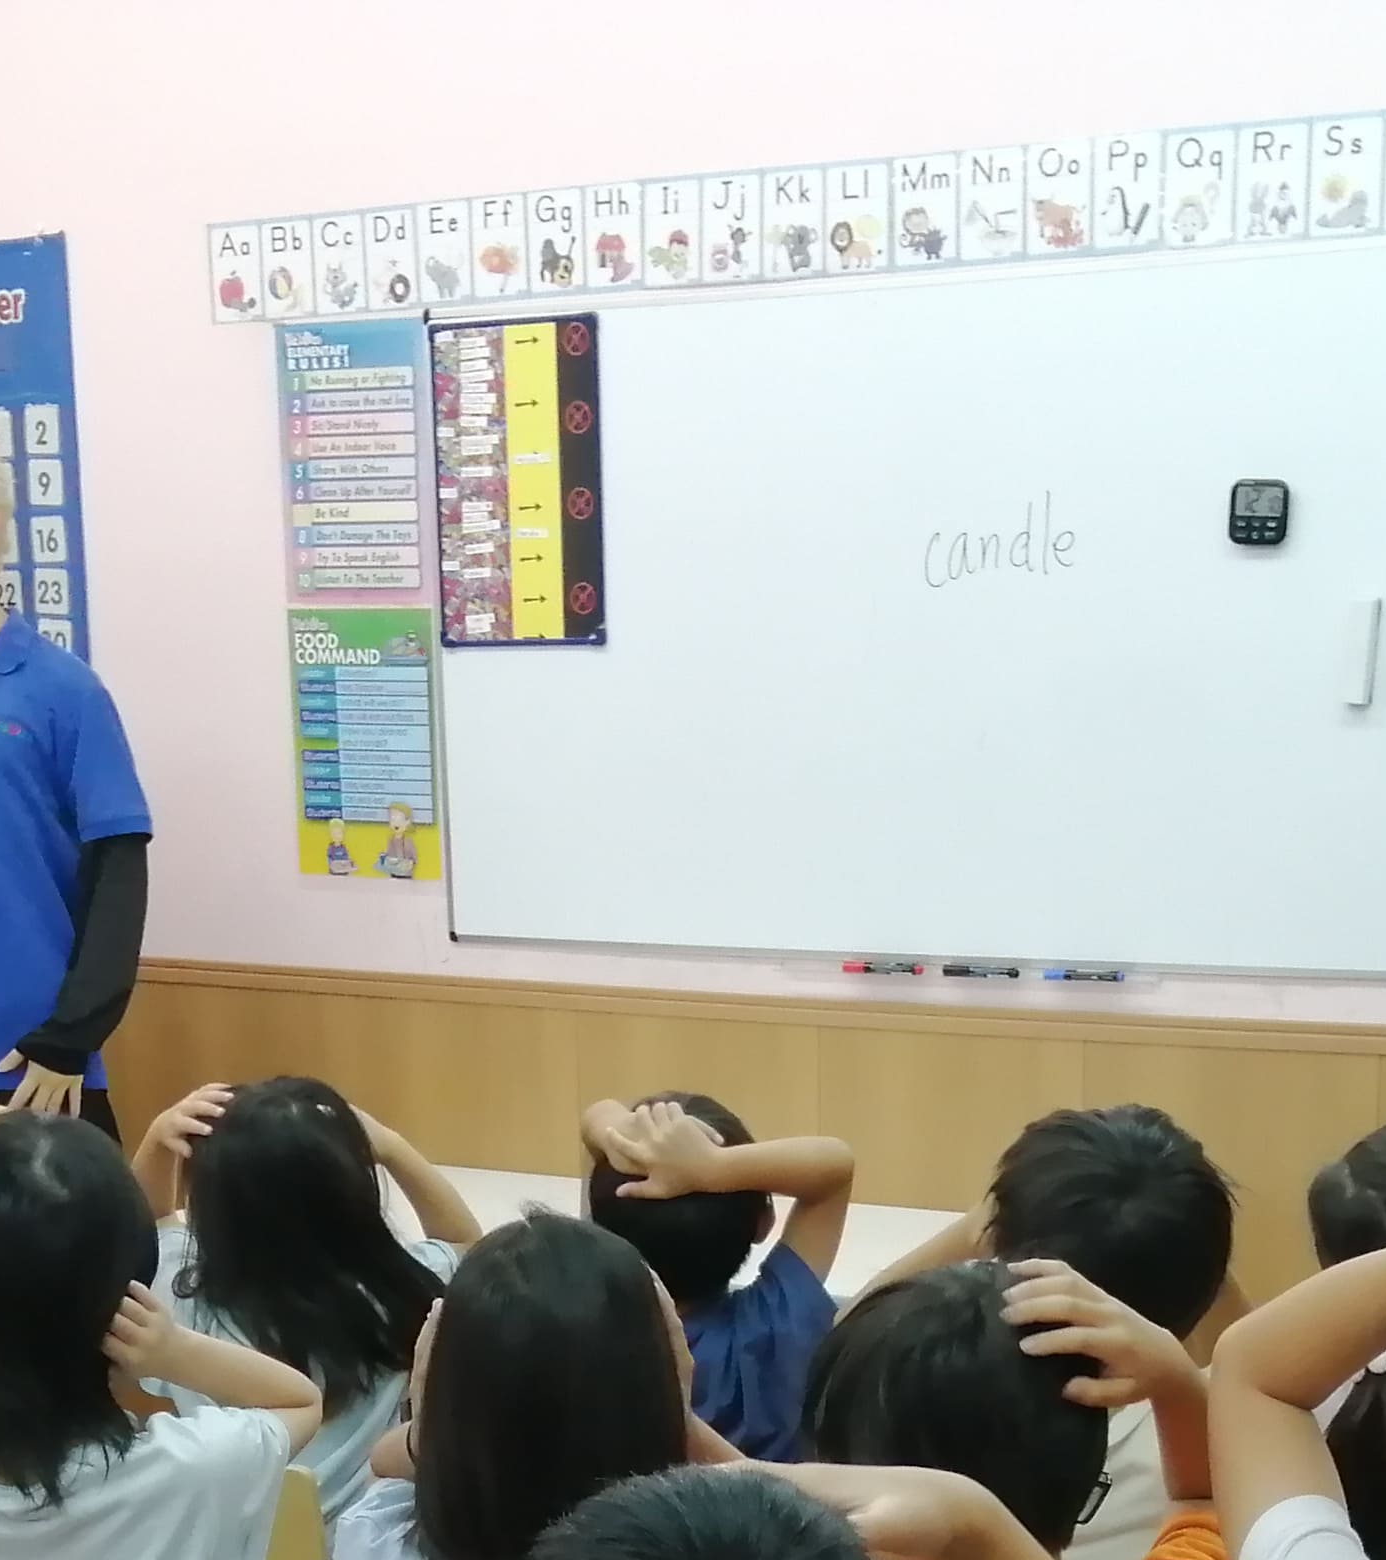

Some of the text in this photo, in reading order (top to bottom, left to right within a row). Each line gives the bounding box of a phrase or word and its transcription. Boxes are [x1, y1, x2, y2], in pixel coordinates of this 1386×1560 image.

[219, 232, 250, 257] Aa
[271, 225, 302, 253] Bb
[321, 221, 353, 248] Cc
[374, 214, 405, 242] Dd
[429, 207, 457, 234] Ee
[484, 200, 512, 228] Ff
[536, 195, 572, 233] Gg
[595, 188, 629, 217] Hh
[662, 186, 679, 214] Ii
[713, 180, 745, 220] Jj
[775, 176, 810, 204] Kk
[842, 169, 868, 199] Ll
[902, 161, 950, 192] Mm
[972, 154, 1010, 184] Nn
[1038, 147, 1079, 177] Oo
[1109, 140, 1147, 181] Pp
[1177, 137, 1222, 180] Qq
[1253, 131, 1291, 163] Rr
[1325, 125, 1362, 156] Ss
[287, 356, 349, 370] RULES!
[293, 399, 301, 413] 2
[35, 421, 48, 445] 2
[293, 421, 302, 434] 3
[295, 464, 303, 478] 5
[38, 472, 51, 496] 9
[296, 487, 304, 499] 6
[329, 507, 350, 518] Kind
[36, 528, 59, 553] 16
[924, 490, 1076, 588] candle
[37, 580, 63, 605] 23
[295, 633, 339, 649] FOOD
[295, 649, 381, 665] COMMAND
